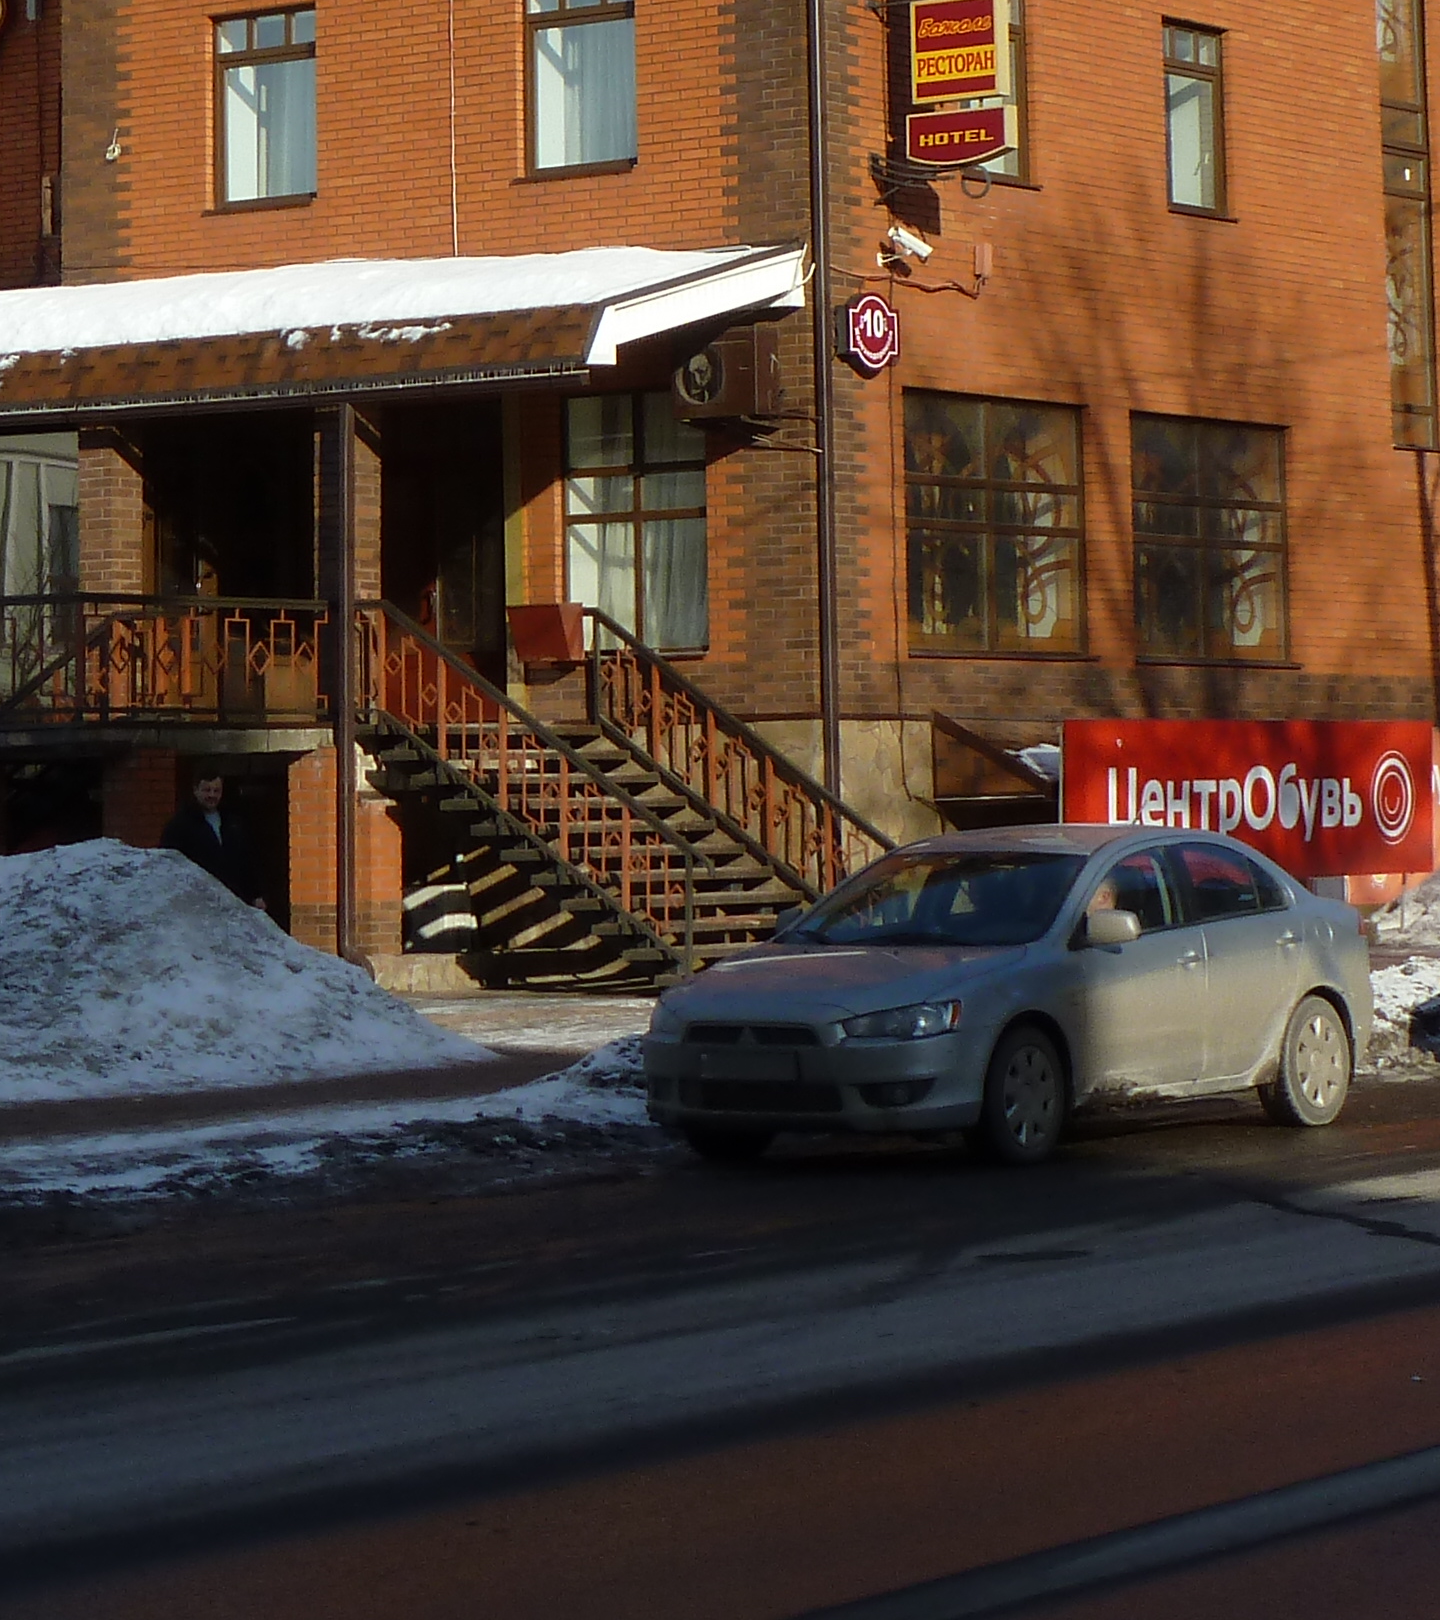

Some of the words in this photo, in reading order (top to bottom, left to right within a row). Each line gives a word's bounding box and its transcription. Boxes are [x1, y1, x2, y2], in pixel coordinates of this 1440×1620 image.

[918, 14, 992, 38] Божоле
[917, 50, 994, 77] РЕСТОРАН
[919, 129, 994, 146] HOTEL
[863, 308, 884, 338] 10
[1107, 762, 1363, 841] ЦентрОбувь
